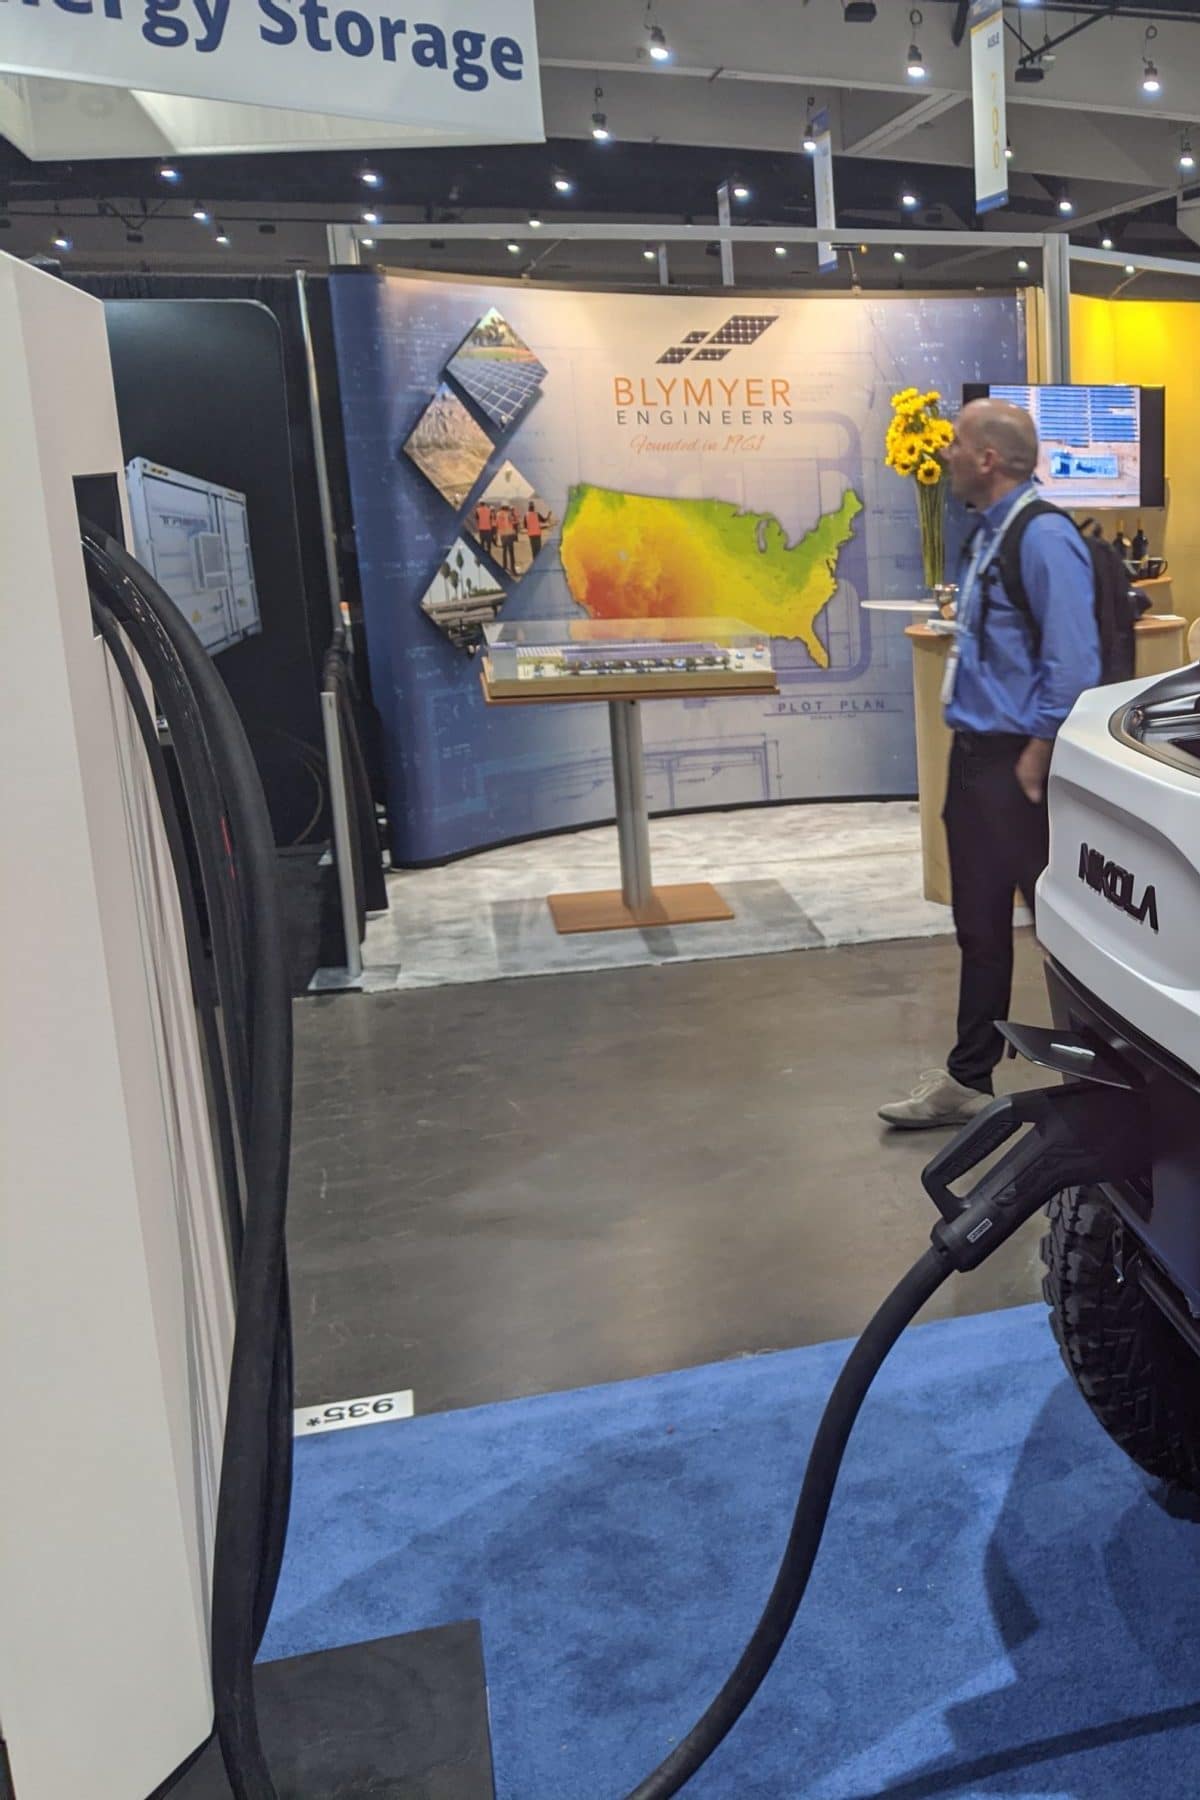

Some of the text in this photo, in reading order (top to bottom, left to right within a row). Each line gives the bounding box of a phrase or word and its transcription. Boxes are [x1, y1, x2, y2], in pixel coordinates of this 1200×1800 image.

[258, 0, 524, 91] Storage
[614, 377, 791, 407] BLYMYER
[617, 410, 793, 425] ENGINEERS
[630, 433, 698, 455] Founded
[702, 438, 719, 451] in
[778, 699, 886, 713] PLOT PLAN
[1079, 842, 1159, 934] NIKOLA
